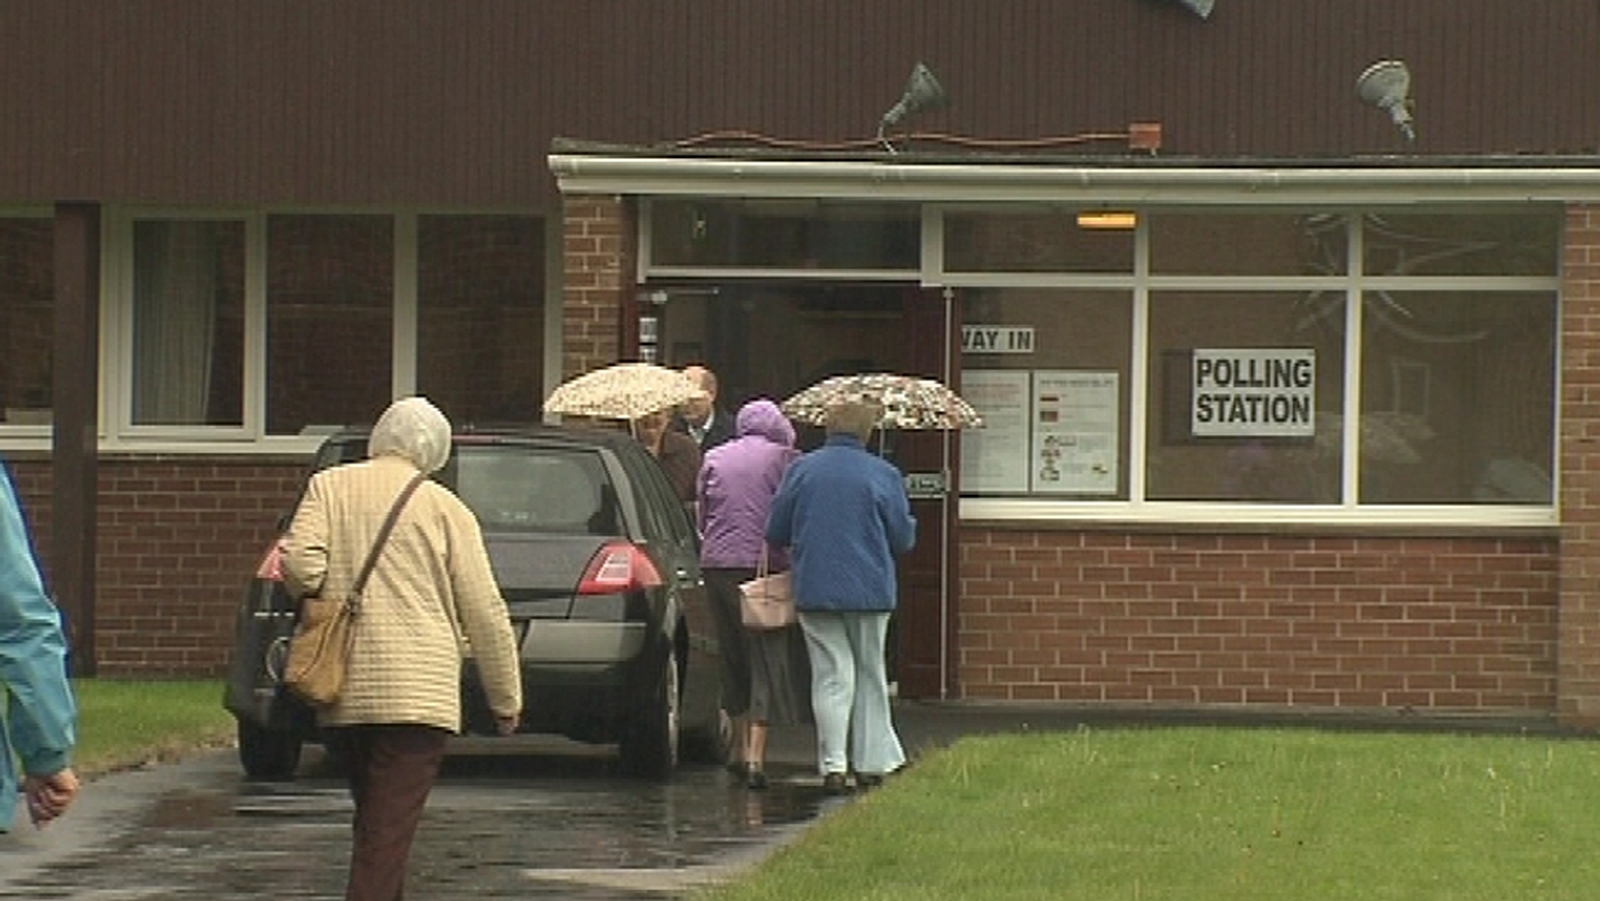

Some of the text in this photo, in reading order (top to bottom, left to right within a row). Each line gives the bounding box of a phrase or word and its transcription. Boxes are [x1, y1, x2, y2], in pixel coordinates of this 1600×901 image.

[1008, 330, 1031, 350] IN
[1197, 359, 1311, 388] POLLING
[1197, 394, 1310, 423] STATION
